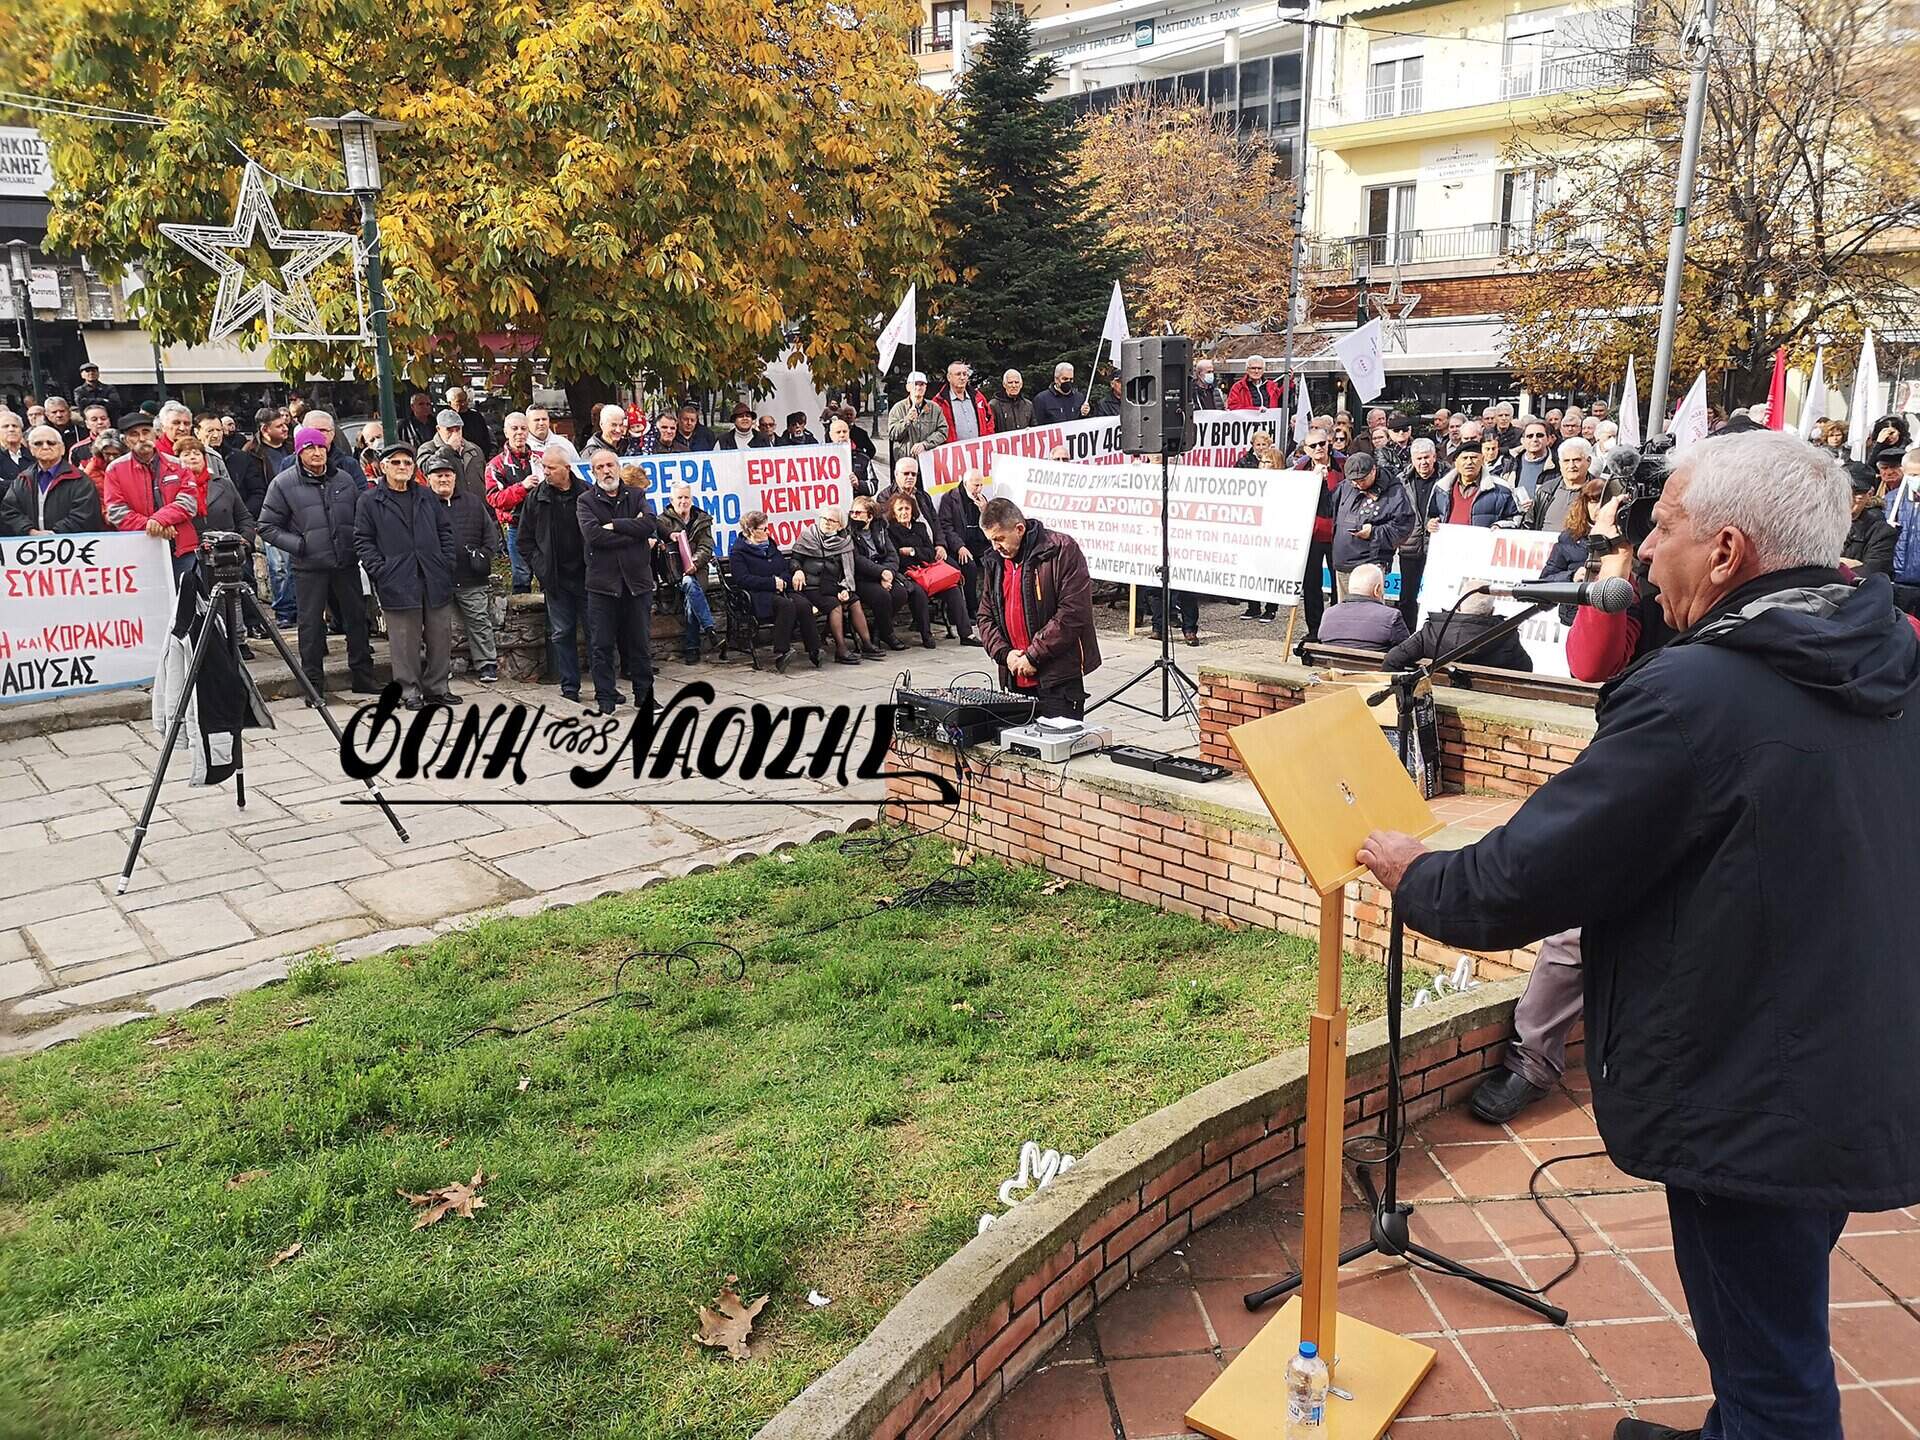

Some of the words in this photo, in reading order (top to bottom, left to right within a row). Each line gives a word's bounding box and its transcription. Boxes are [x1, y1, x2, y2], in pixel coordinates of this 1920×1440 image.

[1157, 16, 1207, 35] NATIONAL
[1210, 8, 1241, 24] BANK
[1052, 43, 1087, 58] ΕΘΝΙΚΗ
[1089, 32, 1133, 50] ΤΡΑΠΕΖΑ
[1065, 431, 1099, 460] ΤΟΥ
[747, 455, 841, 485] ΕΡΓΑΤΙΚΟ
[1026, 467, 1088, 489] ΣΩΜΑΤΕΙΟ
[1088, 473, 1181, 492] ΣΥΝΤΑΞΙΟΥΧΝ
[1184, 475, 1268, 498] ΛΙΤΟΧΩΡΟΥ
[760, 484, 840, 514] ΚΕΝΤΡΟ
[1030, 493, 1064, 510] ΟΛΟΙ
[1065, 496, 1092, 512] ΣΤΟ
[1095, 497, 1154, 516] ΔΡΟΜΟ
[1195, 503, 1257, 524] ΑΓΩΝΑ
[1097, 521, 1119, 533] ΖΩΗ
[1121, 522, 1144, 535] ΜΑΣ
[1170, 528, 1193, 541] ΖΩΗ
[1196, 530, 1219, 543] ΤΩΝ
[1222, 532, 1272, 549] ΠΑΙΔΙΩΝ
[1274, 537, 1300, 551] ΜΑΣ
[16, 539, 100, 566] 650€
[1168, 546, 1239, 566] ΙΚΟΓΕΝΕΙΑΣ
[5, 566, 138, 597] ΣΥΝΤΑΞΕΙΣ
[1094, 557, 1169, 578] ΑΝΤΕΡΓΑΤΙΚ
[1240, 574, 1303, 596] ΠΟΛΙΤΙΚΕΣ
[43, 616, 143, 653] ΚΟΡΑΚΙΩΝ
[2, 655, 99, 696] ΑΟΥΣΑΣ
